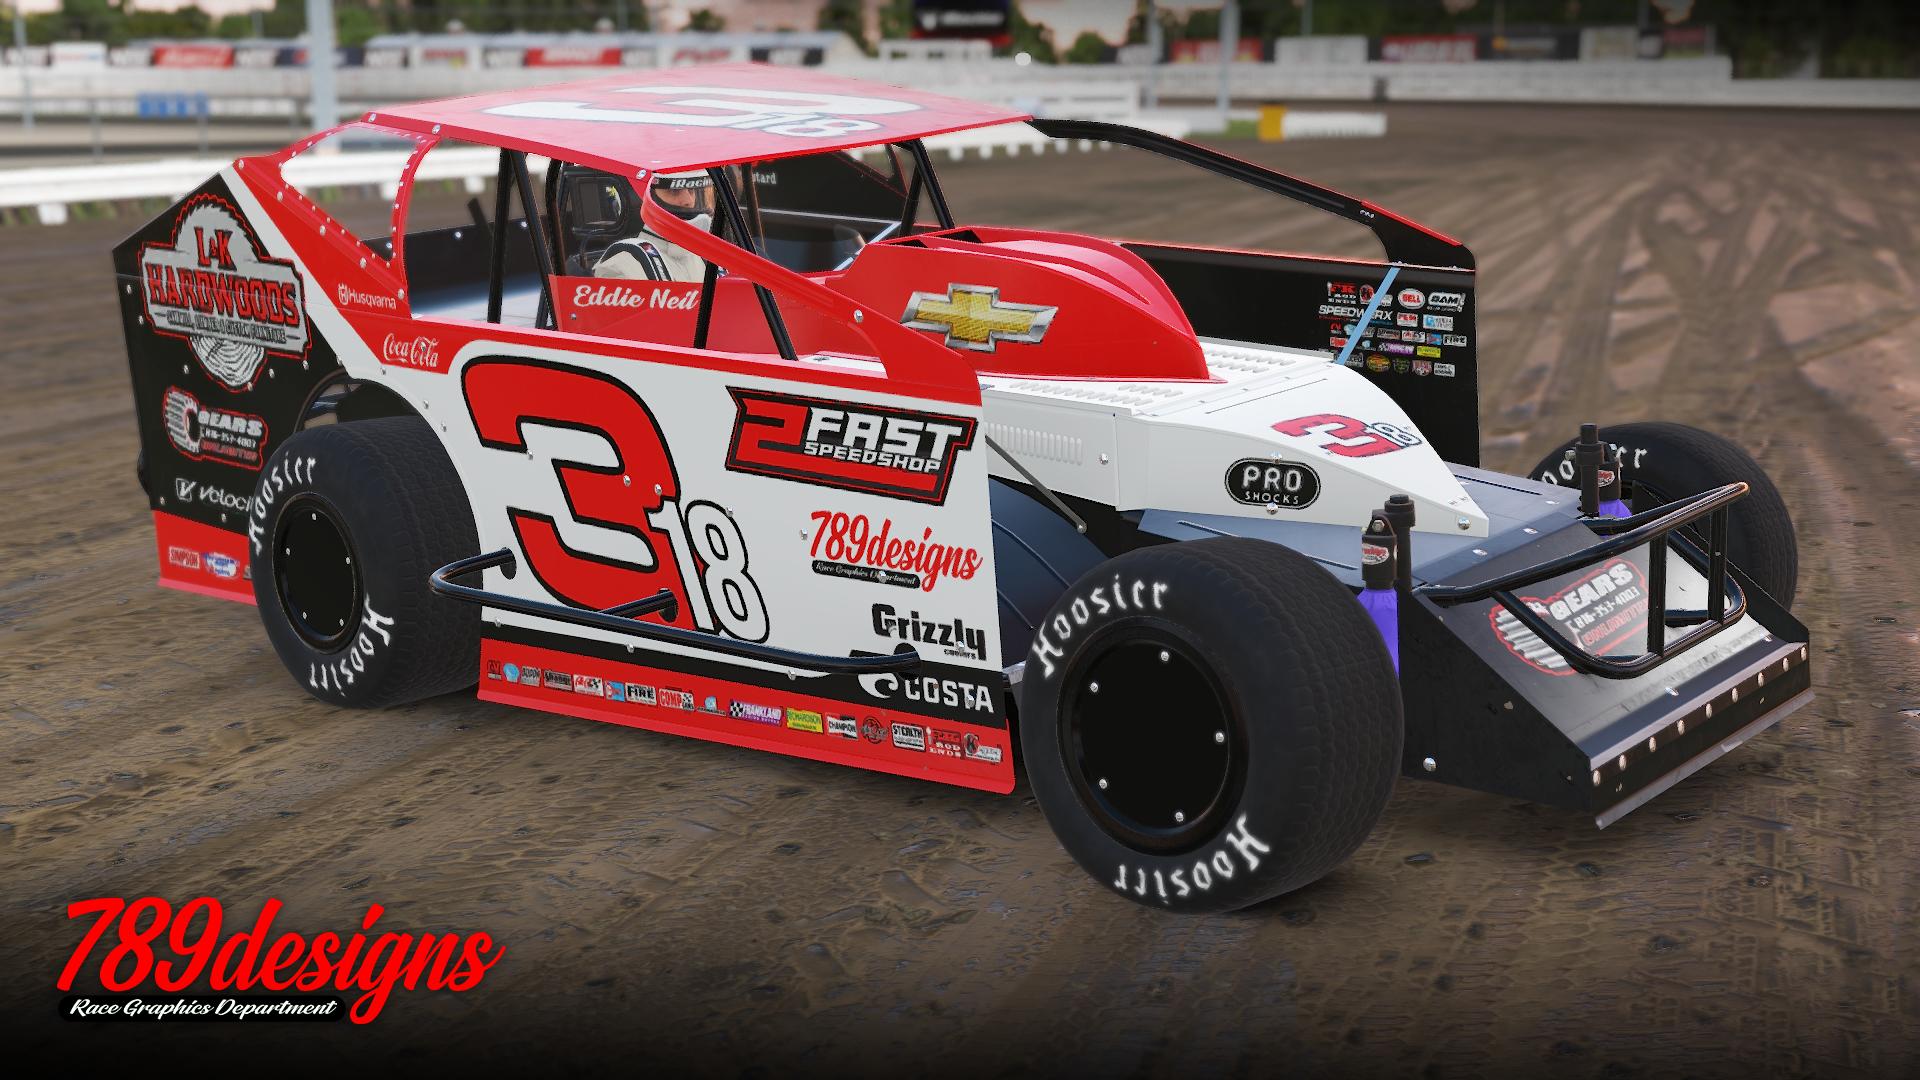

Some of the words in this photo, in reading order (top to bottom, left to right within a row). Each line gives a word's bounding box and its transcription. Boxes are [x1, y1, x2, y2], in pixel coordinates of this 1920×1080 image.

[670, 177, 713, 189] iRacin
[194, 226, 237, 271] L&K
[145, 262, 301, 328] HARDWOODS
[348, 288, 397, 310] Husqvarna
[573, 284, 645, 308] Eddie
[650, 288, 699, 311] Neil
[1402, 293, 1421, 304] BELL
[1318, 304, 1393, 321] SPEEDWRX
[807, 405, 963, 461] FAST
[1270, 413, 1404, 458] 3
[803, 441, 941, 474] SPEEDSHOP
[1242, 465, 1301, 492] PRO
[249, 451, 316, 557] Hoosier
[461, 355, 681, 633] 3
[643, 499, 770, 645] 18
[1245, 490, 1299, 505] SHOCKS
[170, 549, 199, 567] SIMPSON
[810, 510, 983, 592] 789designs
[872, 603, 987, 661] Grizzly
[1032, 573, 1169, 679] Hoosier
[309, 592, 395, 698] Hoosier
[660, 690, 681, 707] COMP
[905, 677, 994, 713] COSTA
[743, 704, 782, 721] FRANKLAND
[828, 721, 857, 733] CHAMPION
[1113, 812, 1271, 905] Hoosier
